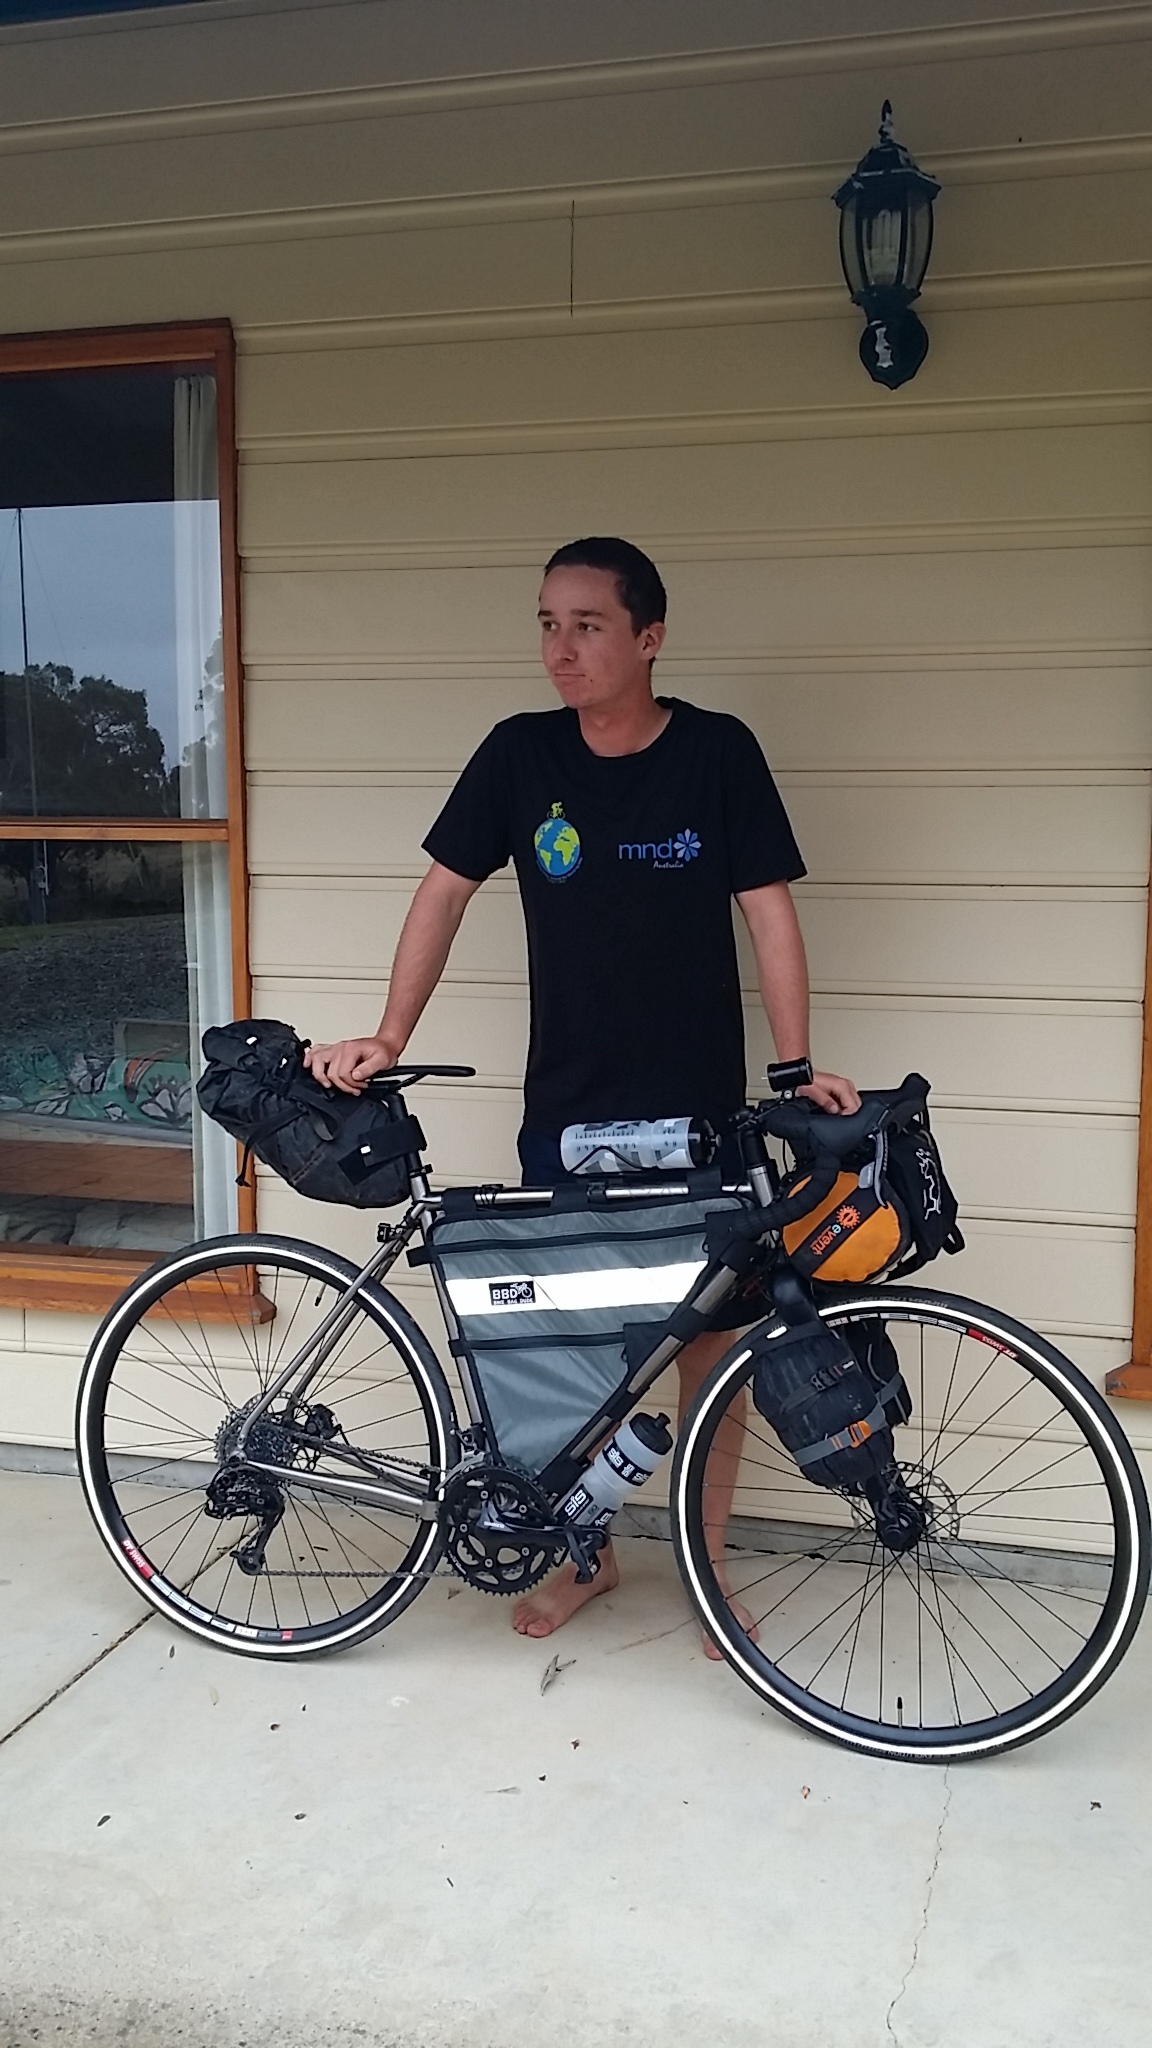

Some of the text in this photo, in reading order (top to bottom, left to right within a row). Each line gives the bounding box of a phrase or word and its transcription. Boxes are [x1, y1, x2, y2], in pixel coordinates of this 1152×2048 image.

[618, 838, 673, 860] mnd
[653, 860, 685, 869] Australia
[492, 1288, 518, 1300] BBD
